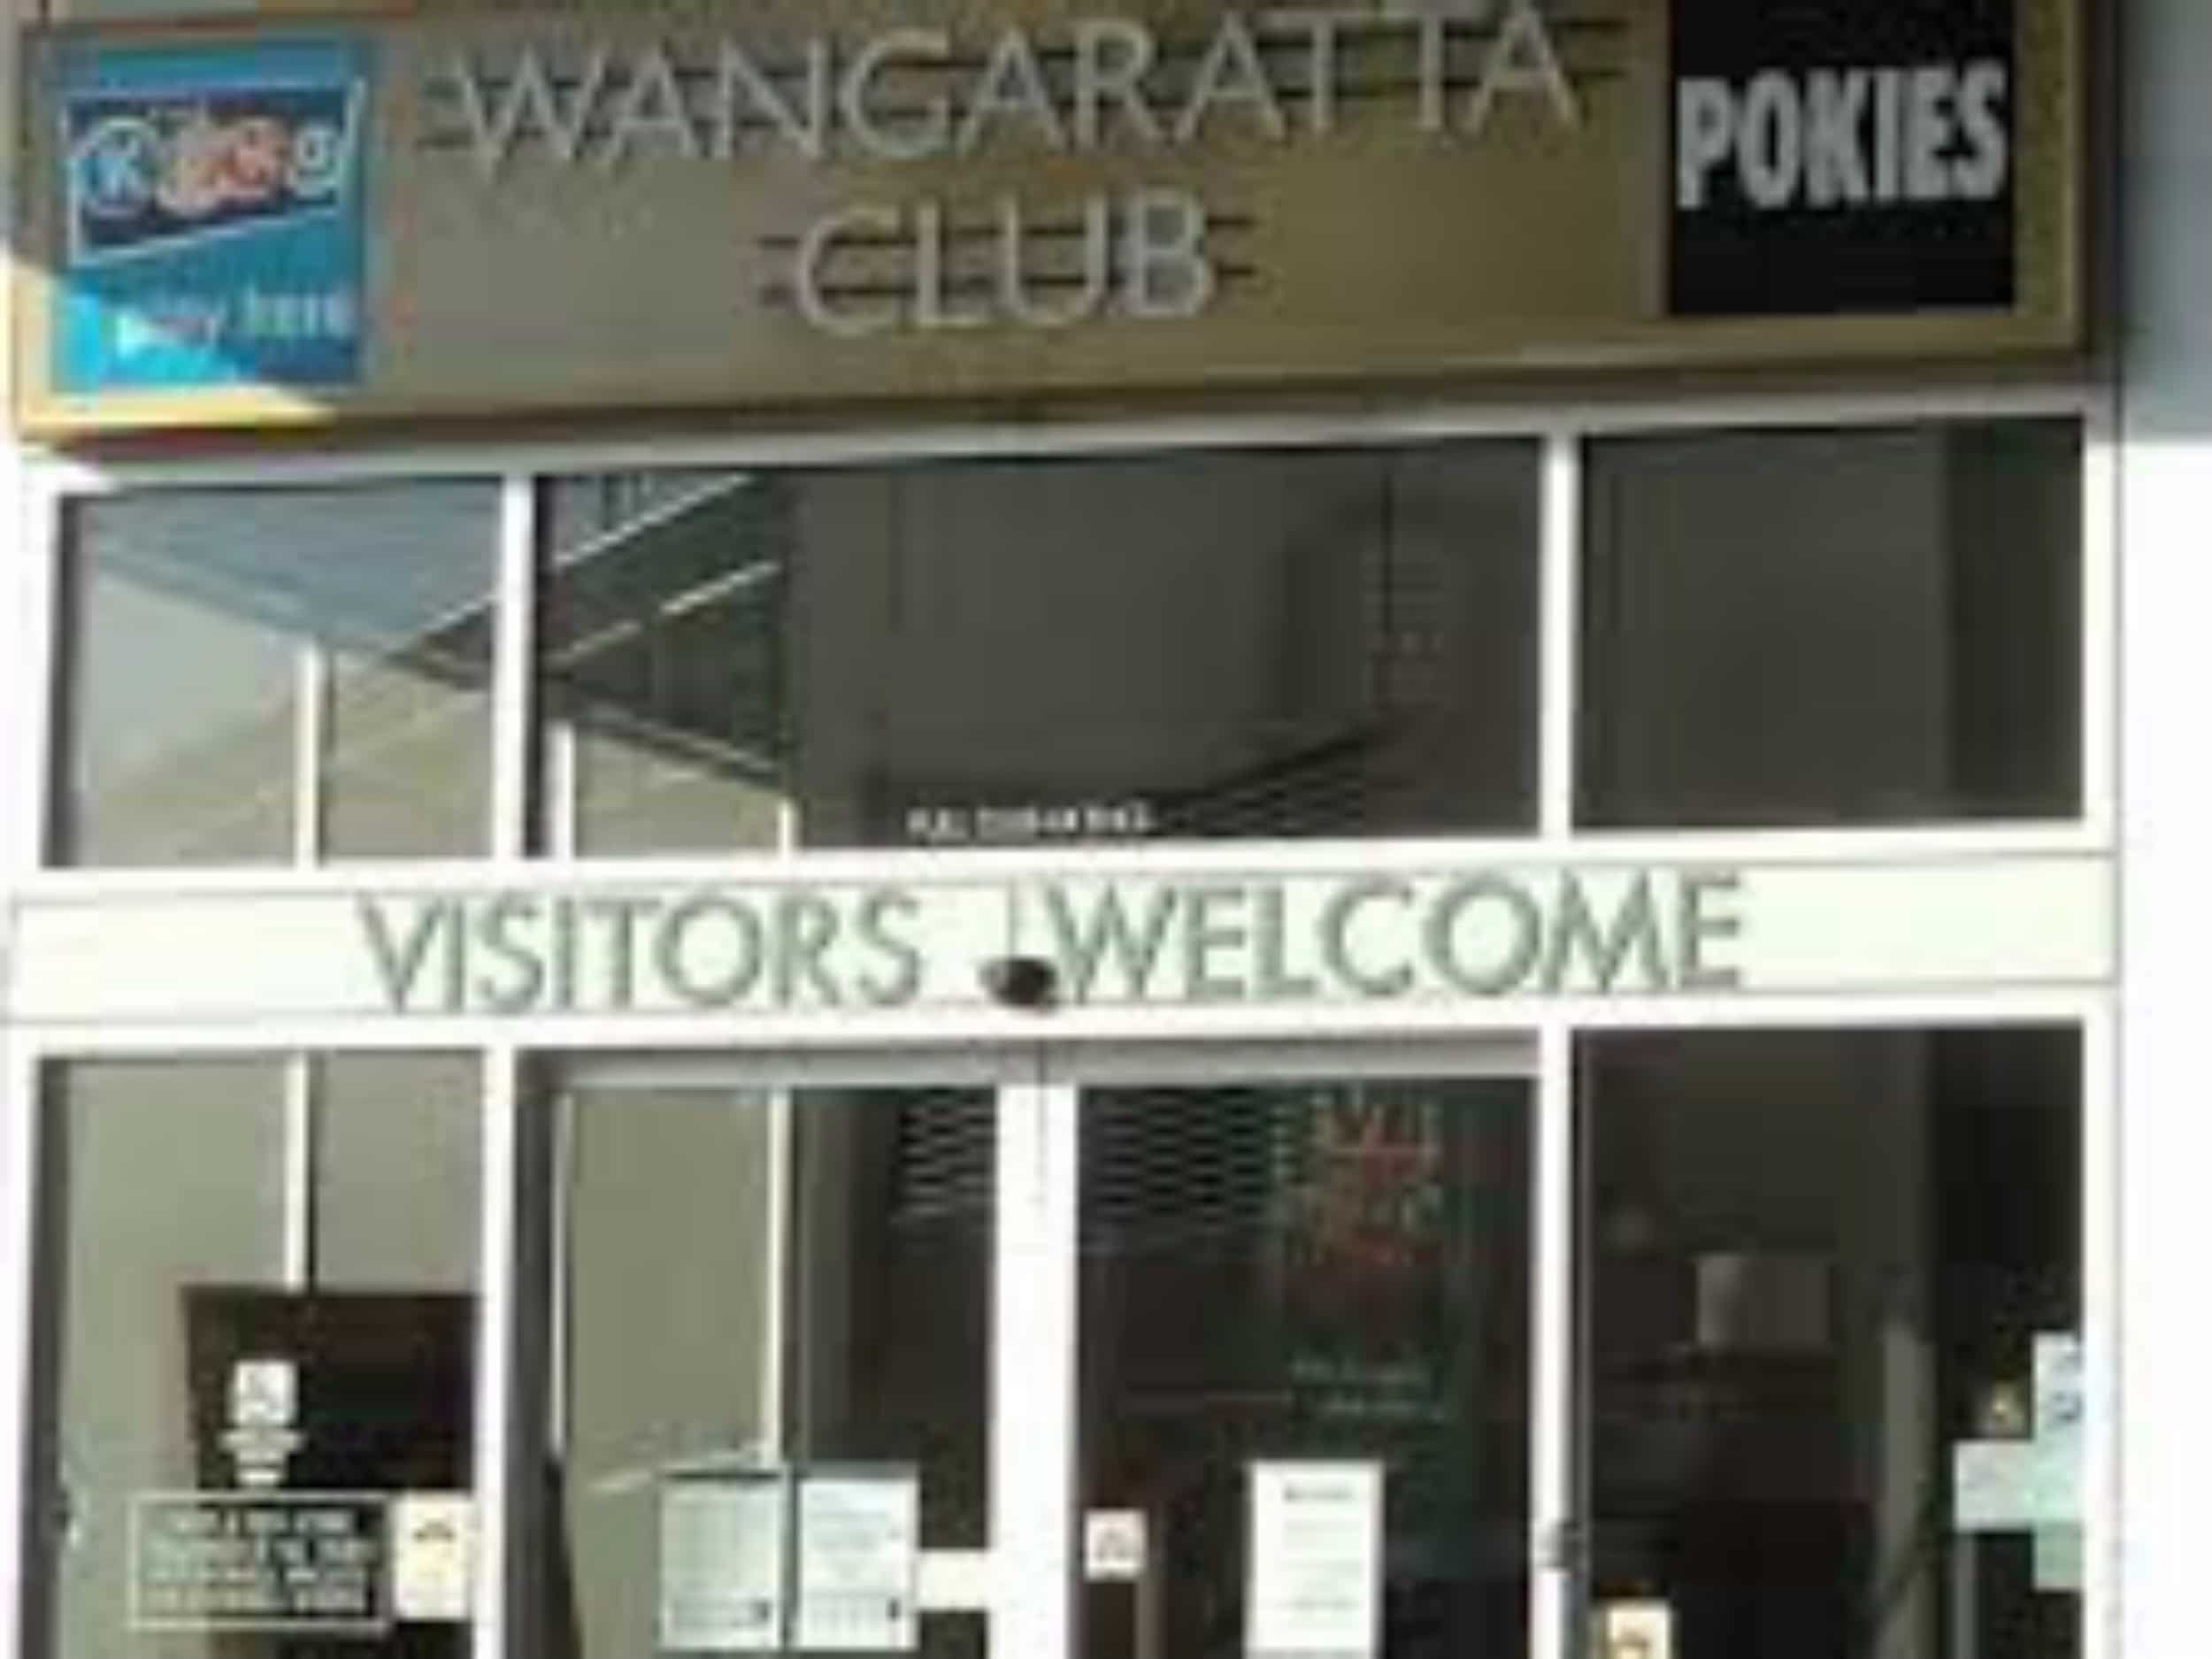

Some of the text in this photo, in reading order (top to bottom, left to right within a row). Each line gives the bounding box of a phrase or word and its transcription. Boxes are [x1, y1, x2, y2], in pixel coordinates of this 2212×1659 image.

[453, 0, 1584, 179] WANGARATTA
[1678, 58, 2008, 210] POKIES
[797, 188, 1216, 335] CLUB
[356, 871, 1750, 1014] VISITORS WELCOME
